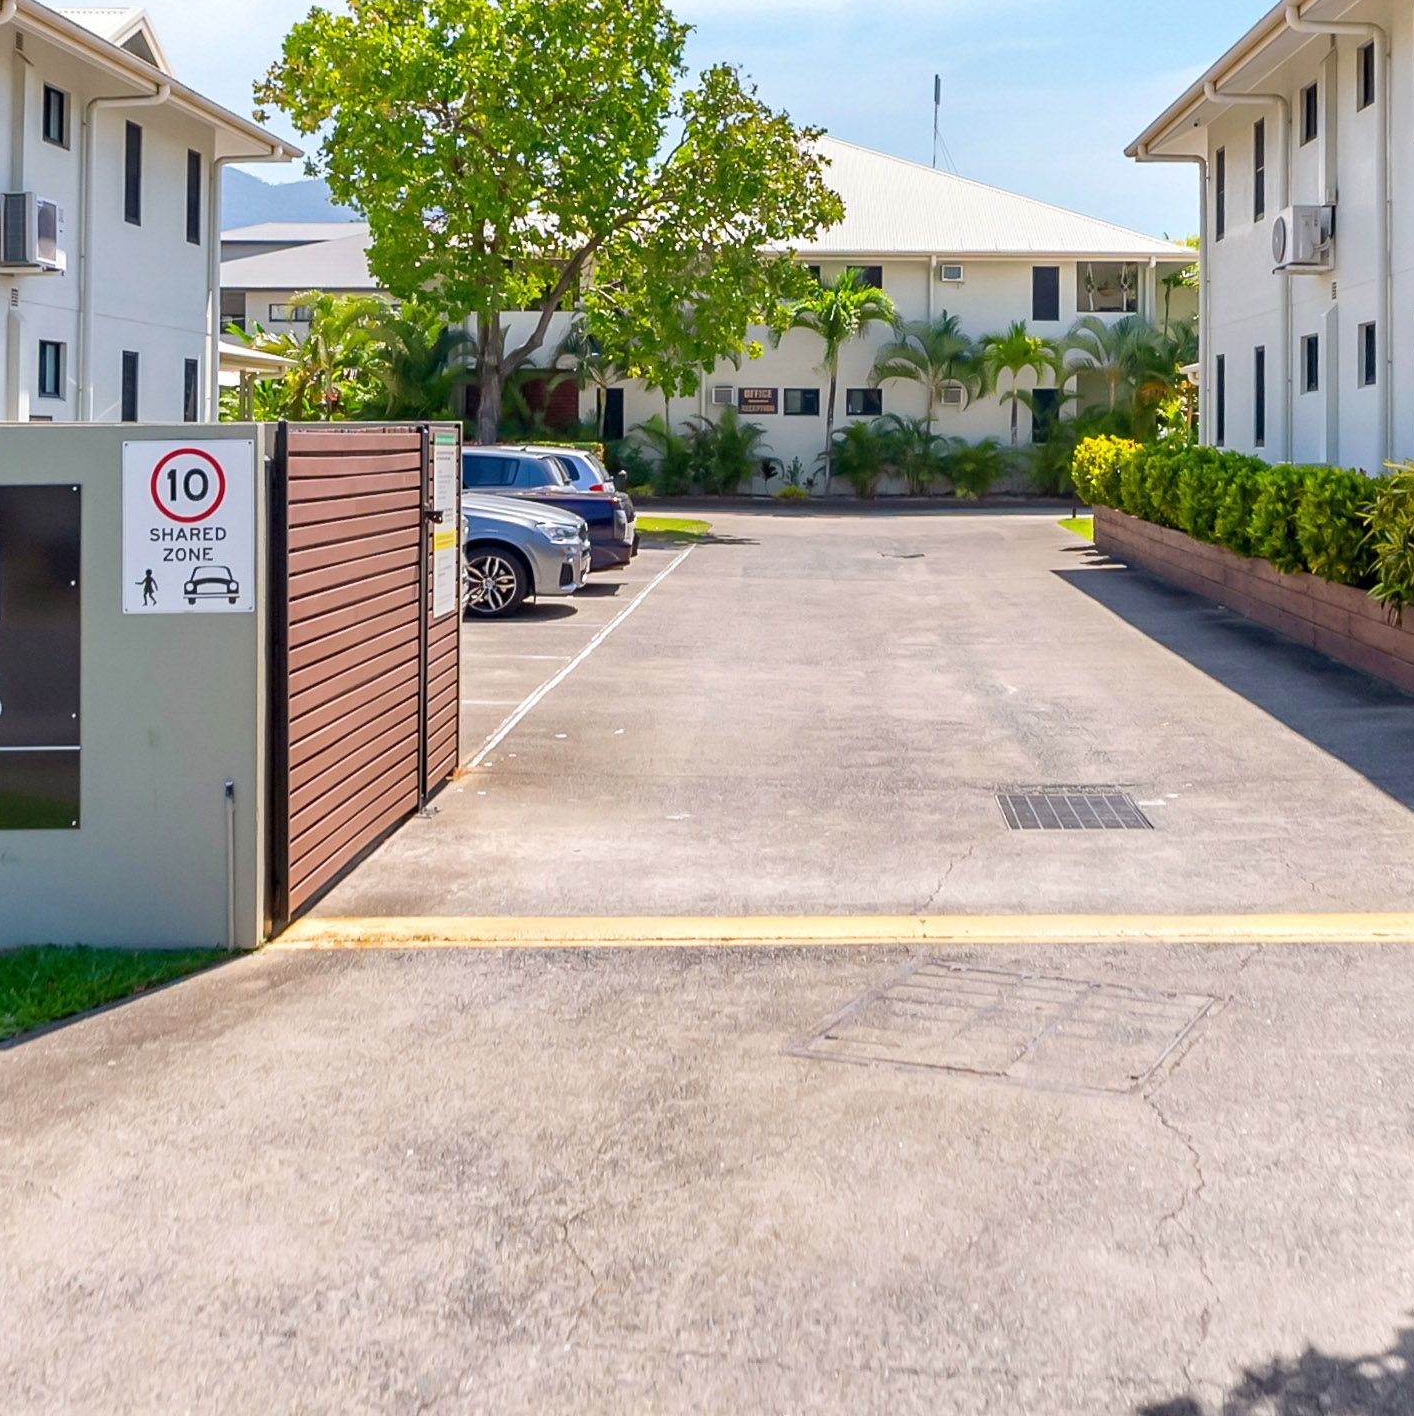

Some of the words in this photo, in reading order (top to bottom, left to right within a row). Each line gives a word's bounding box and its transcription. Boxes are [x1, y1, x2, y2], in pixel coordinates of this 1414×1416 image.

[743, 389, 772, 398] OFFICE
[167, 468, 209, 502] 10
[149, 526, 227, 542] SHARED
[163, 547, 214, 562] ZONE
